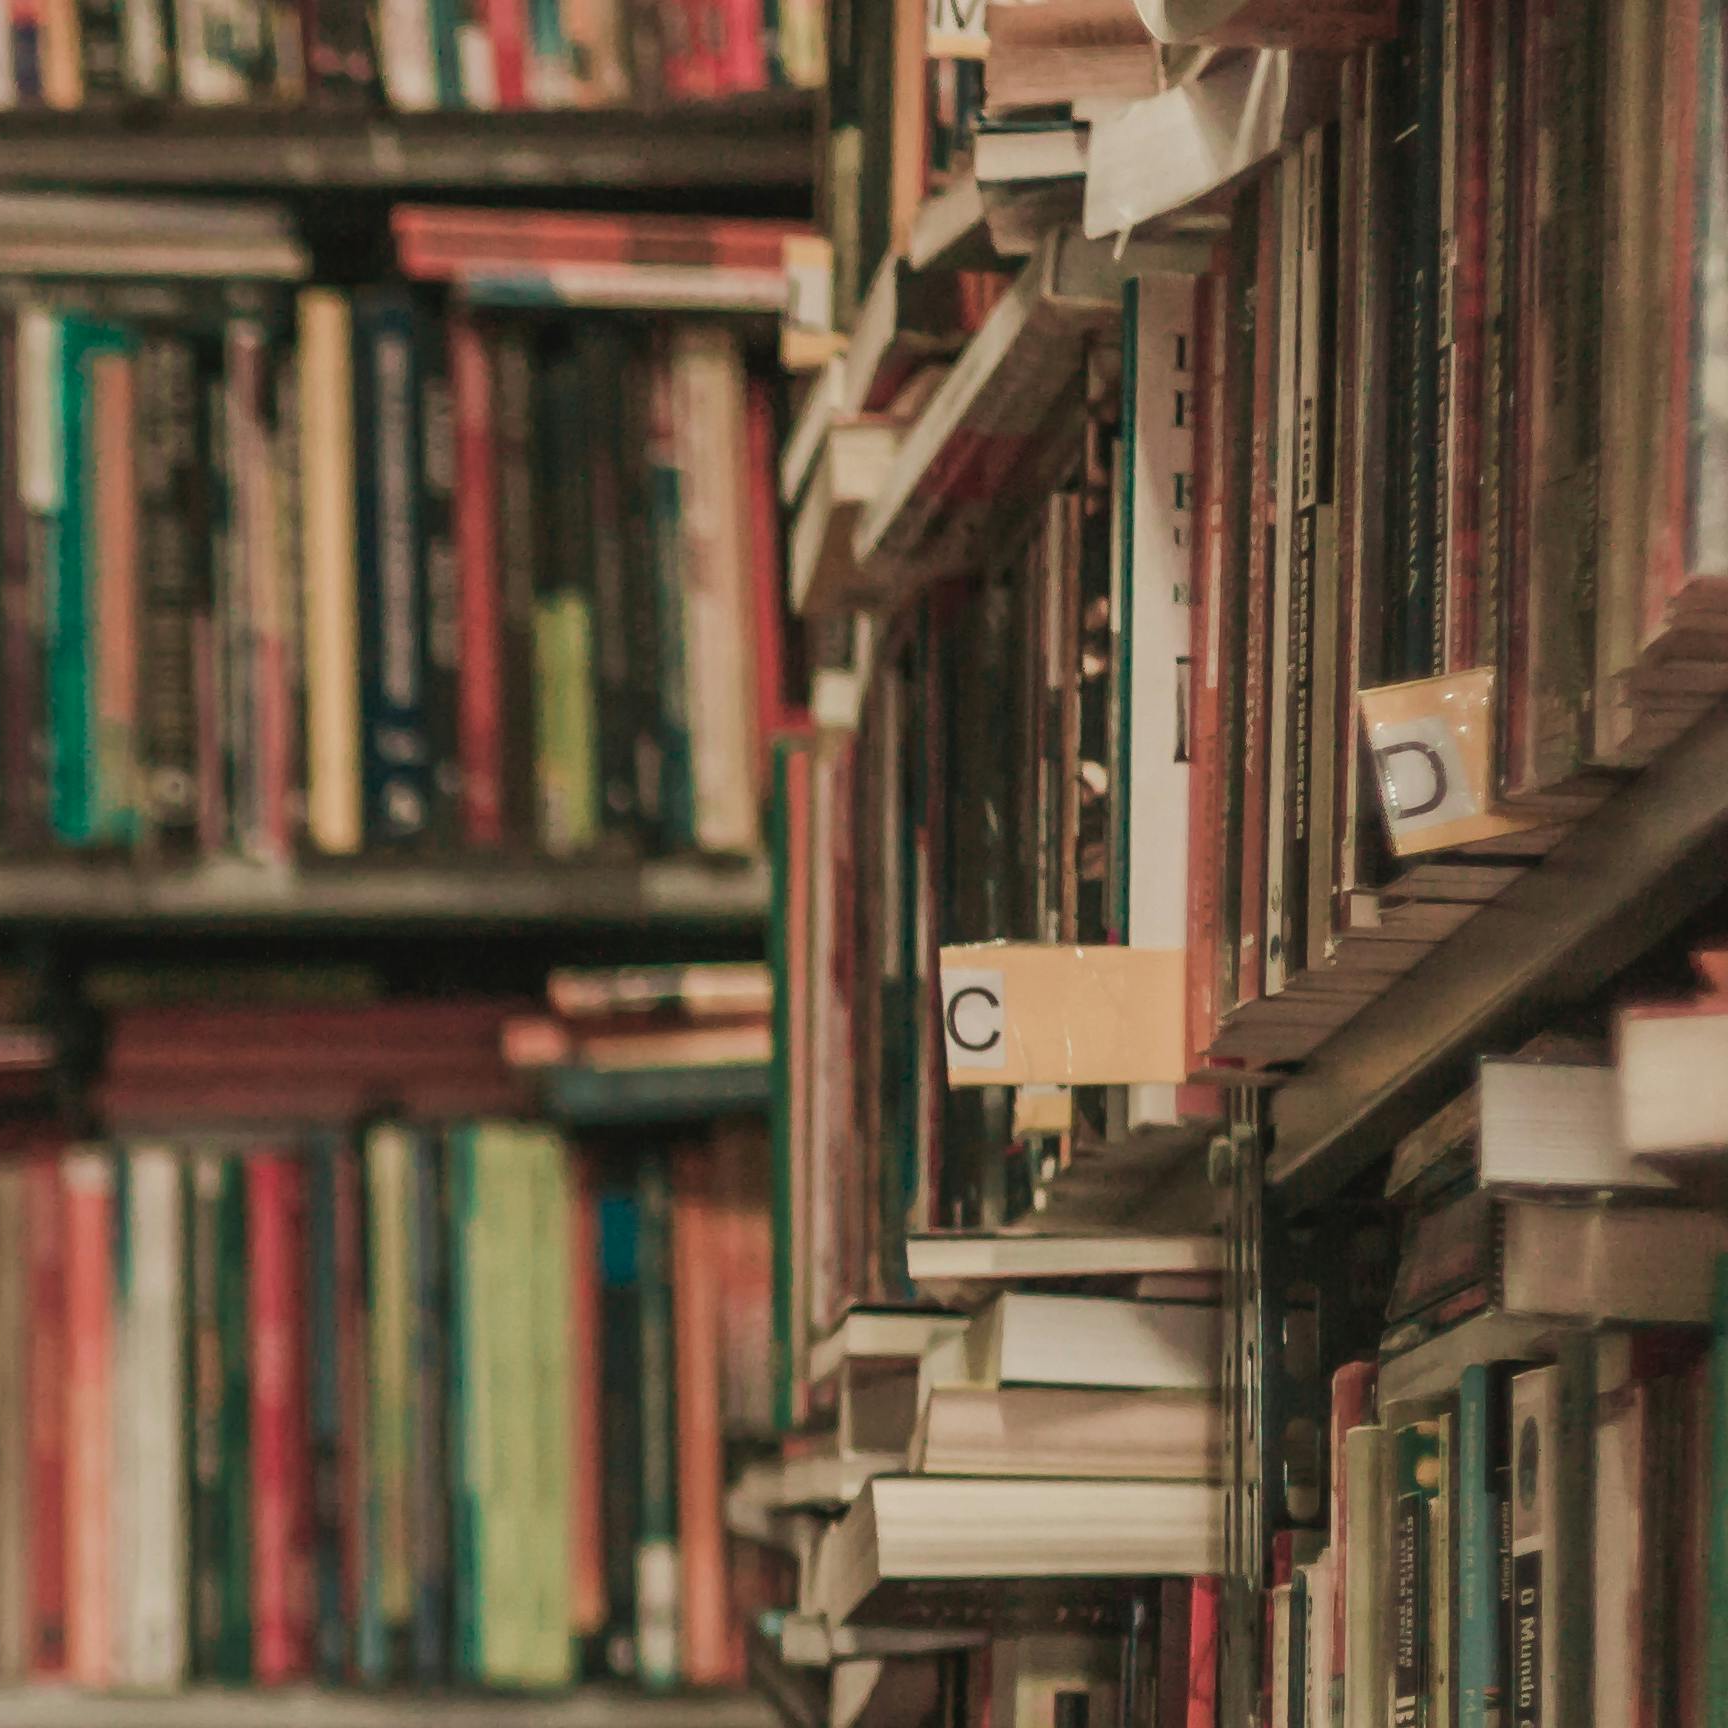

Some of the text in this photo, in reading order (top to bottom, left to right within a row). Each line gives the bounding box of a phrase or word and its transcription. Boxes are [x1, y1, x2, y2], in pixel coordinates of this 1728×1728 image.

[1380, 742, 1449, 817] D
[946, 986, 1002, 1052] C
[1520, 1588, 1536, 1607] O
[1520, 1616, 1536, 1707] Mundo
